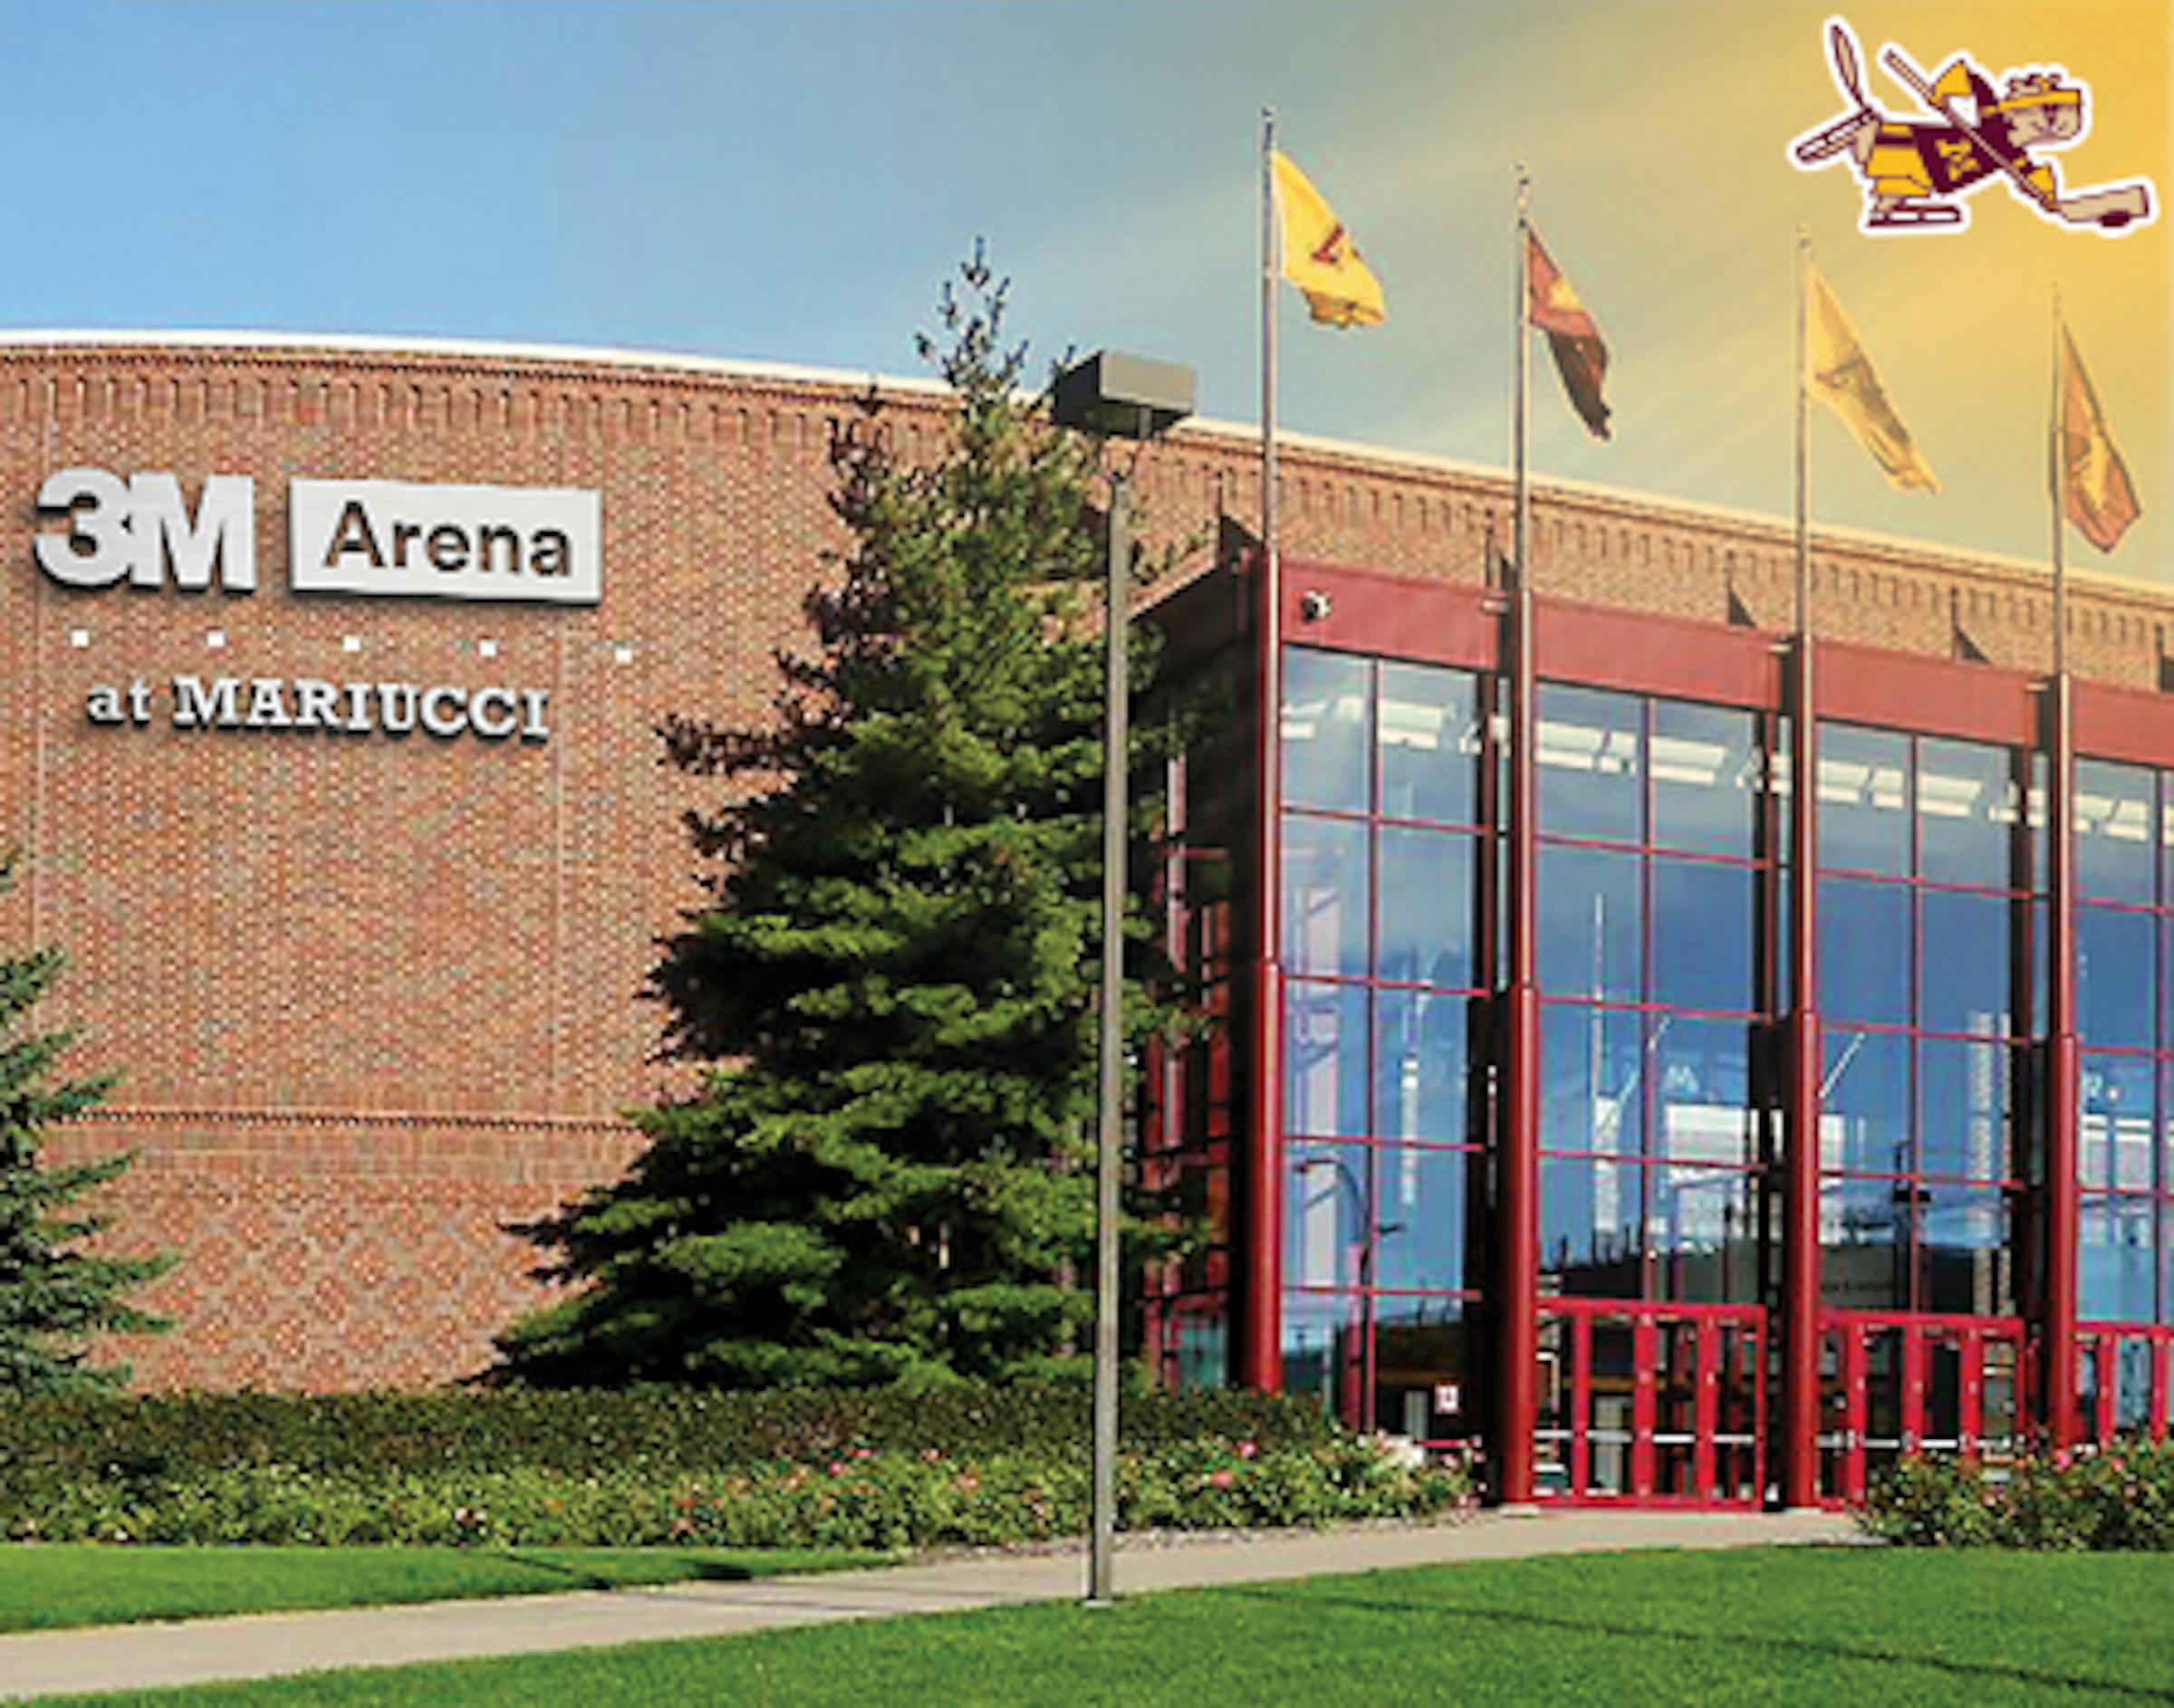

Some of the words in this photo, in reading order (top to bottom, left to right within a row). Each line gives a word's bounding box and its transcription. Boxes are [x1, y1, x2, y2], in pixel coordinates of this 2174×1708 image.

[35, 467, 255, 591] 3M
[323, 499, 571, 576] Arena
[87, 681, 151, 723] at
[172, 676, 551, 738] MARIUCCI
